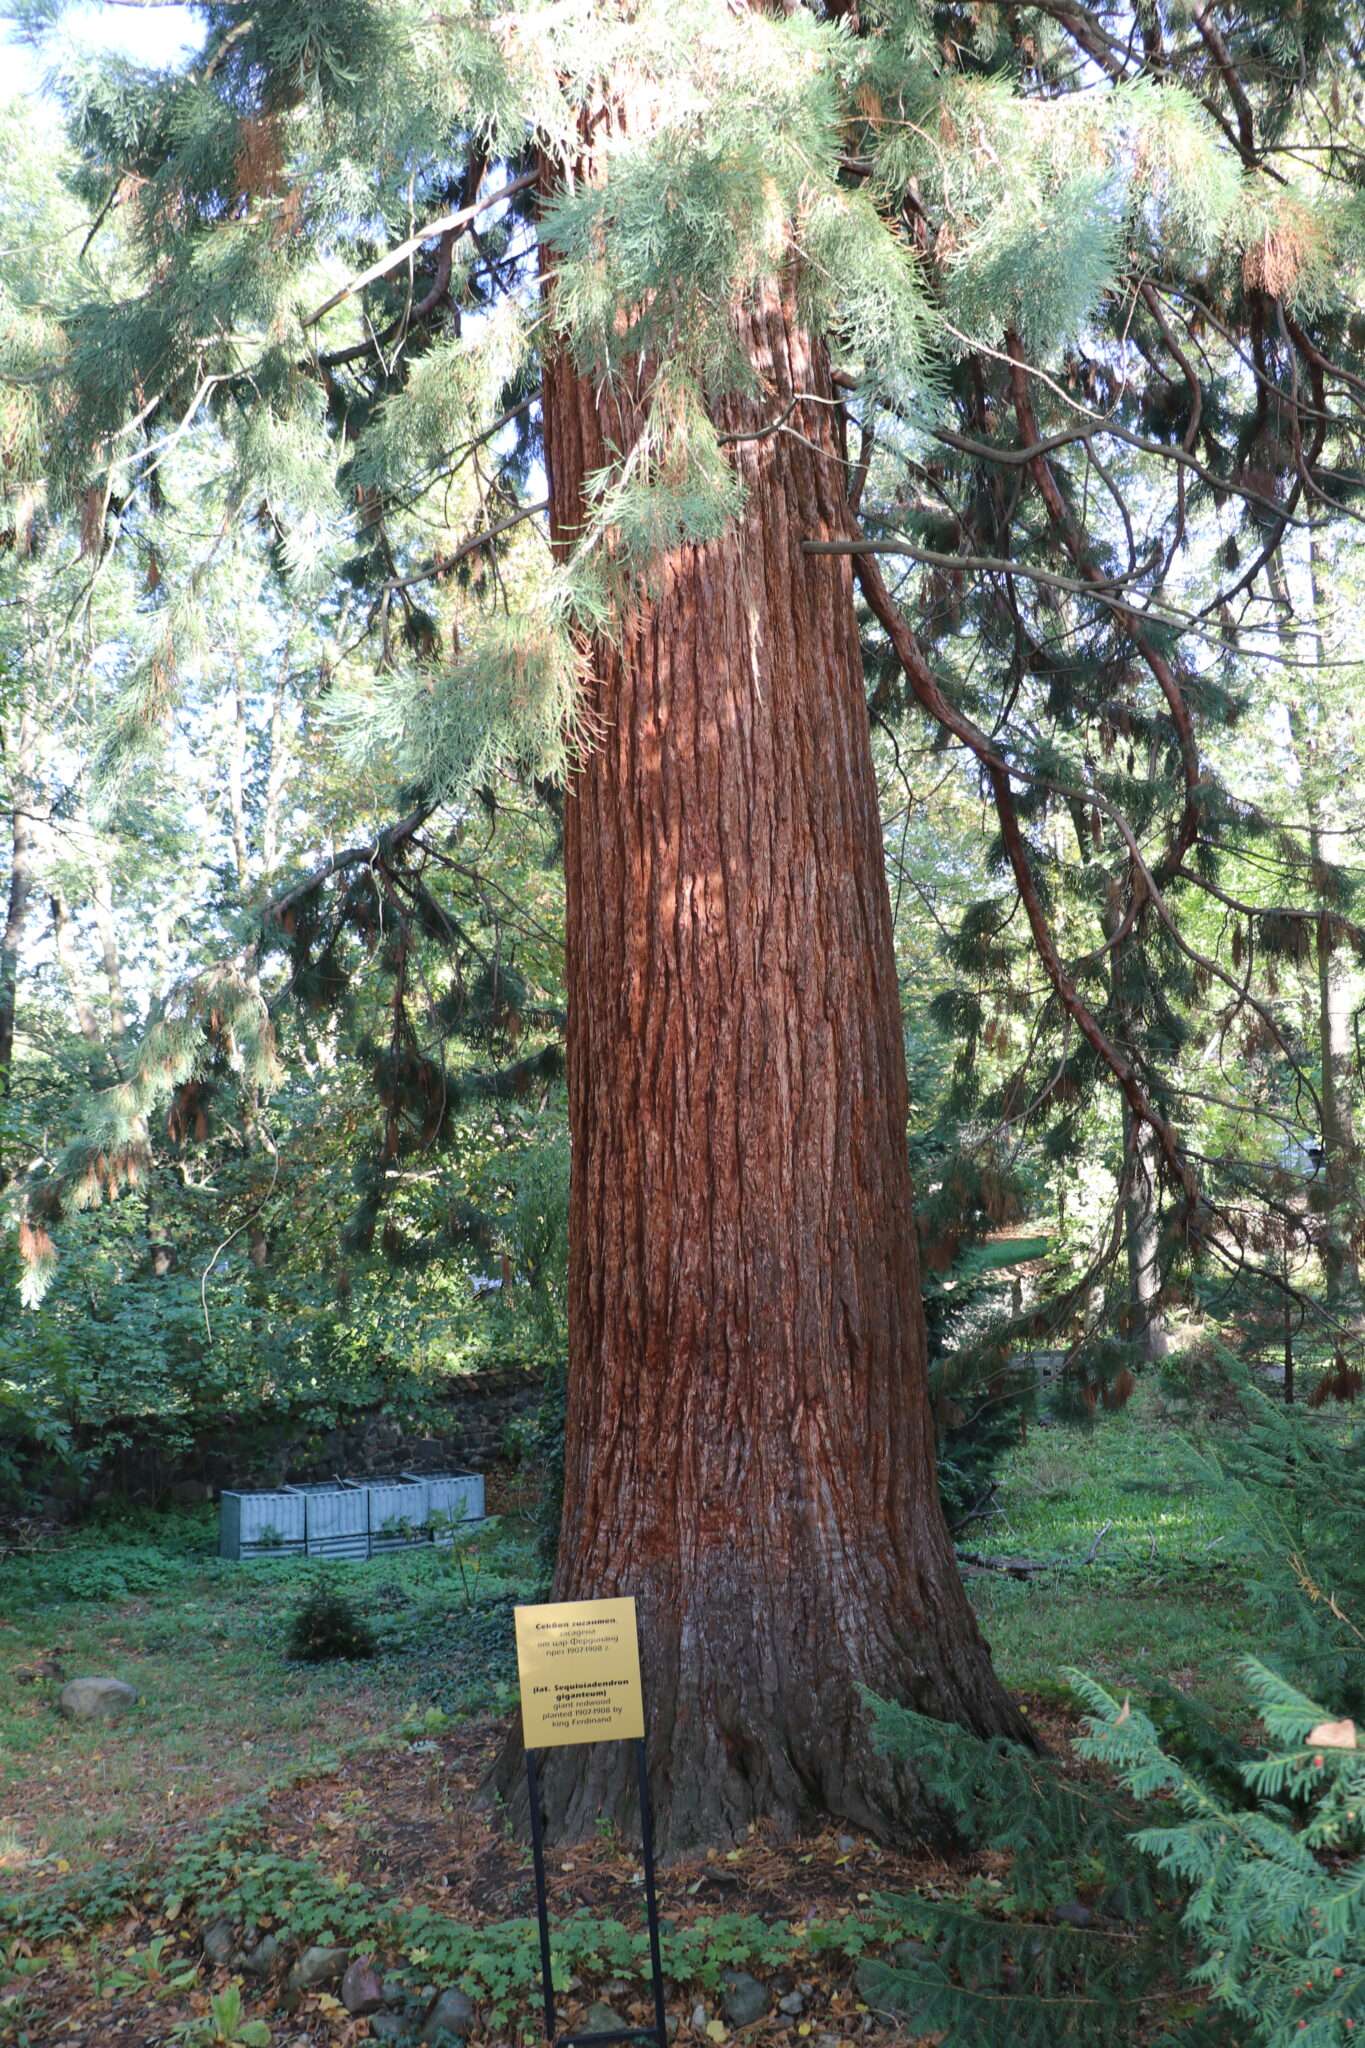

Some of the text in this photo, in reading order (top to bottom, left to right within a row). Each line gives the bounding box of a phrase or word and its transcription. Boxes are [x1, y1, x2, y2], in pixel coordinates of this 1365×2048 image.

[576, 1697, 611, 1708] redwood
[542, 1711, 572, 1721] planted
[613, 1705, 623, 1715] by
[571, 1715, 612, 1726] Ferdinand
